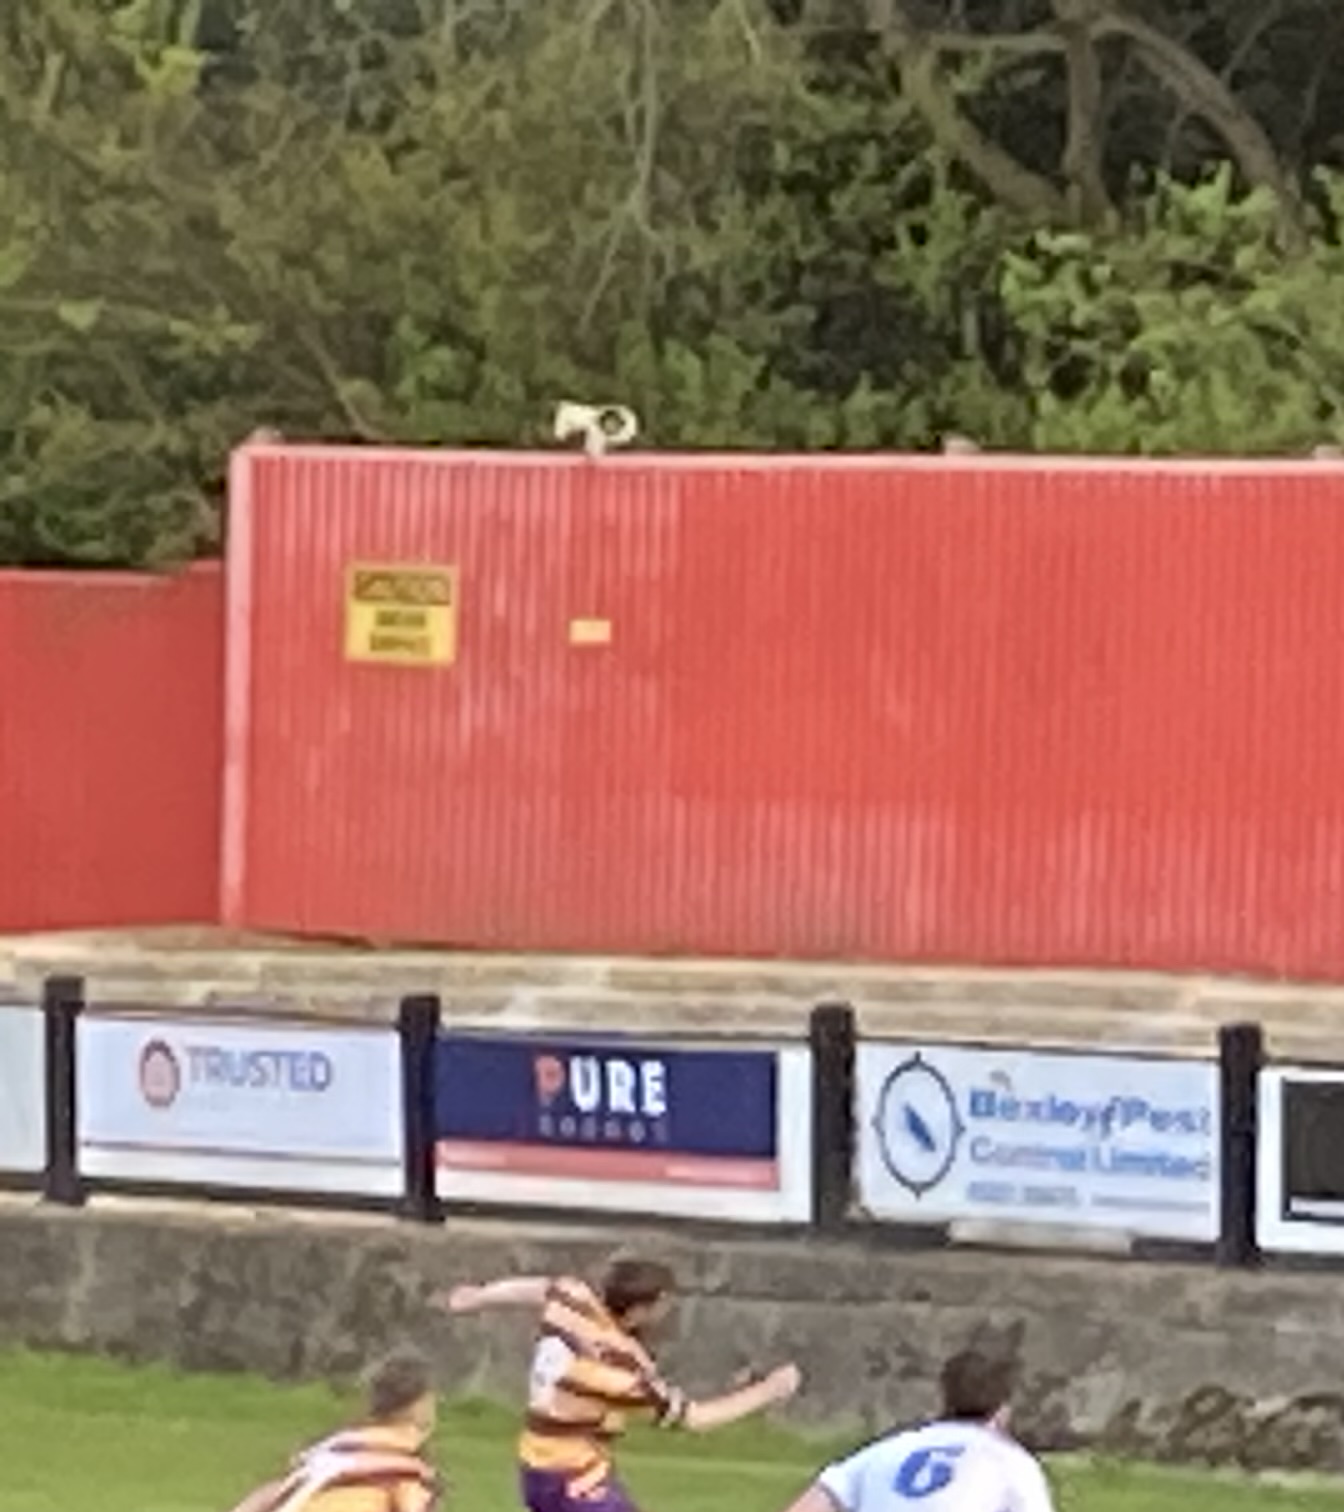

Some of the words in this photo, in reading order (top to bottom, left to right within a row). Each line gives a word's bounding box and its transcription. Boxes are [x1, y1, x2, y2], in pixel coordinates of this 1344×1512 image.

[187, 1047, 332, 1092] TRUSTED
[536, 1056, 667, 1116] PURE
[893, 1446, 965, 1500] 6
